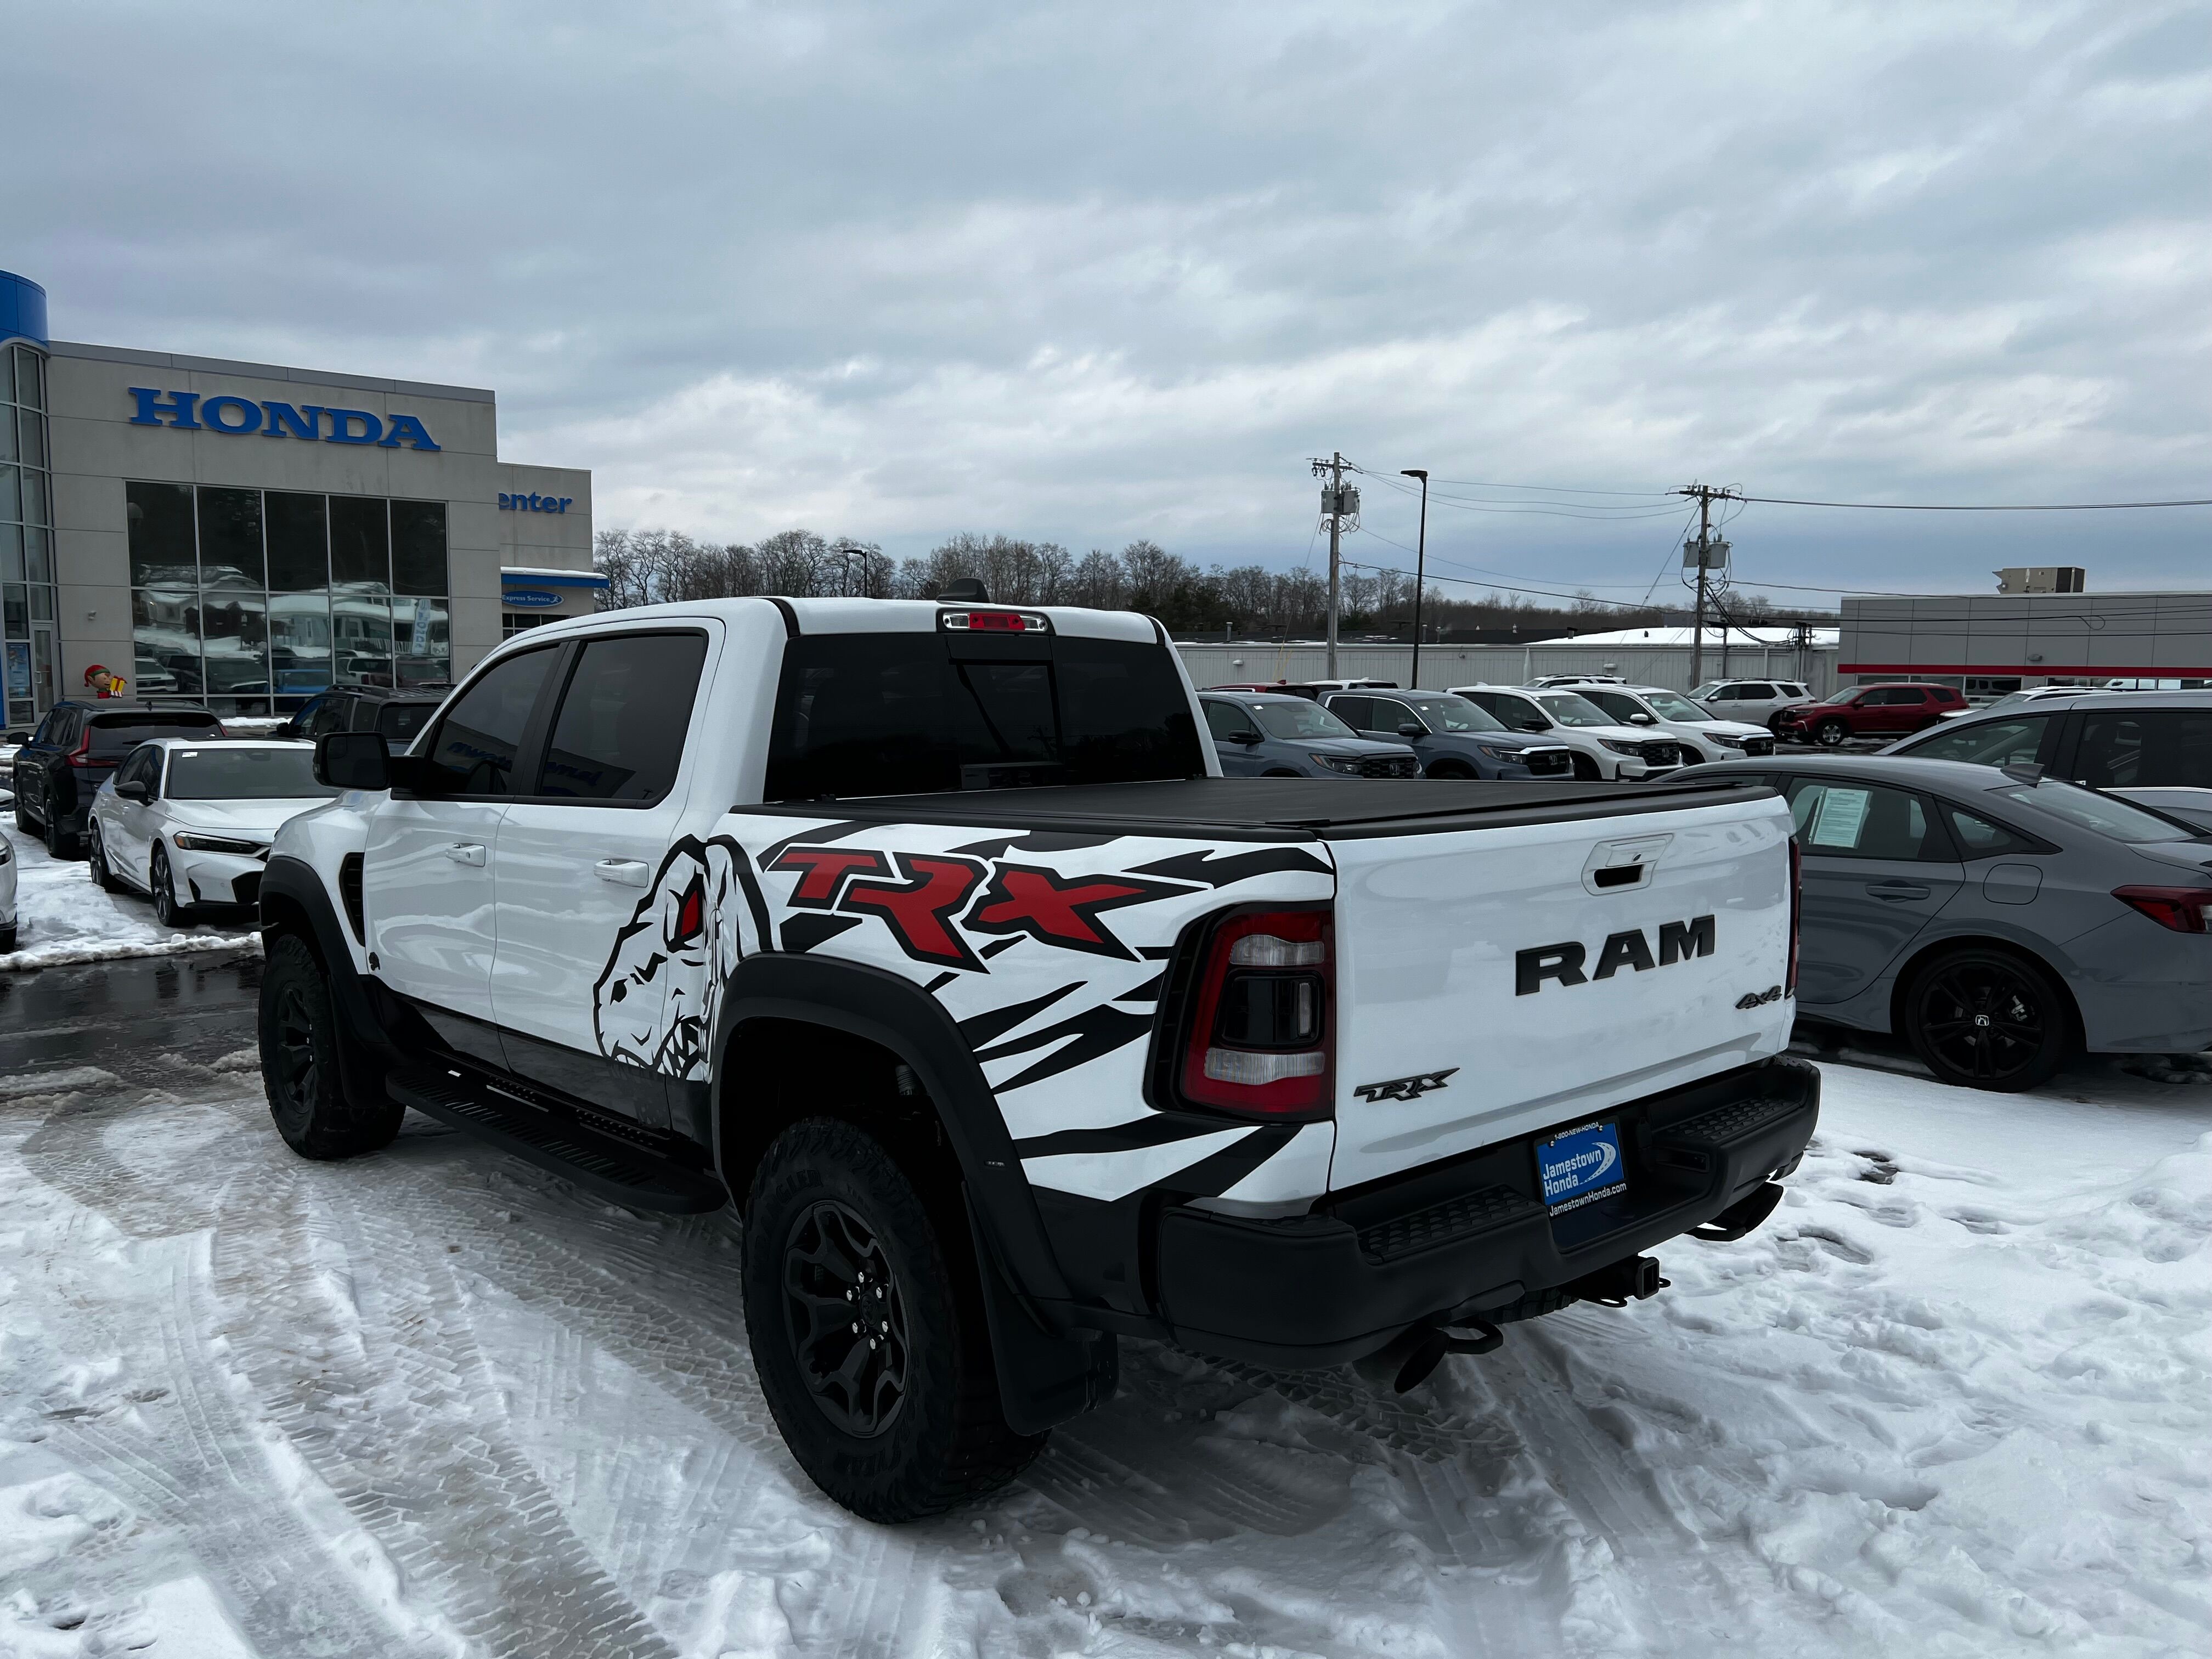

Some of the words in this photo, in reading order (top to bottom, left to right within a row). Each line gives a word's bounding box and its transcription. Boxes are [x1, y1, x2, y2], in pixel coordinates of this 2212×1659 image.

[128, 387, 441, 451] HONDA
[498, 492, 572, 513] enter
[769, 847, 1185, 971] TRX
[1516, 915, 1715, 996] RAM
[1353, 1068, 1460, 1103] TRX
[1554, 1122, 1599, 1140] 1-800-NEW-HONDA
[1543, 1149, 1602, 1180] Jamestown
[1544, 1172, 1579, 1197] Honda
[1549, 1182, 1627, 1217] JamestownHonda.com
